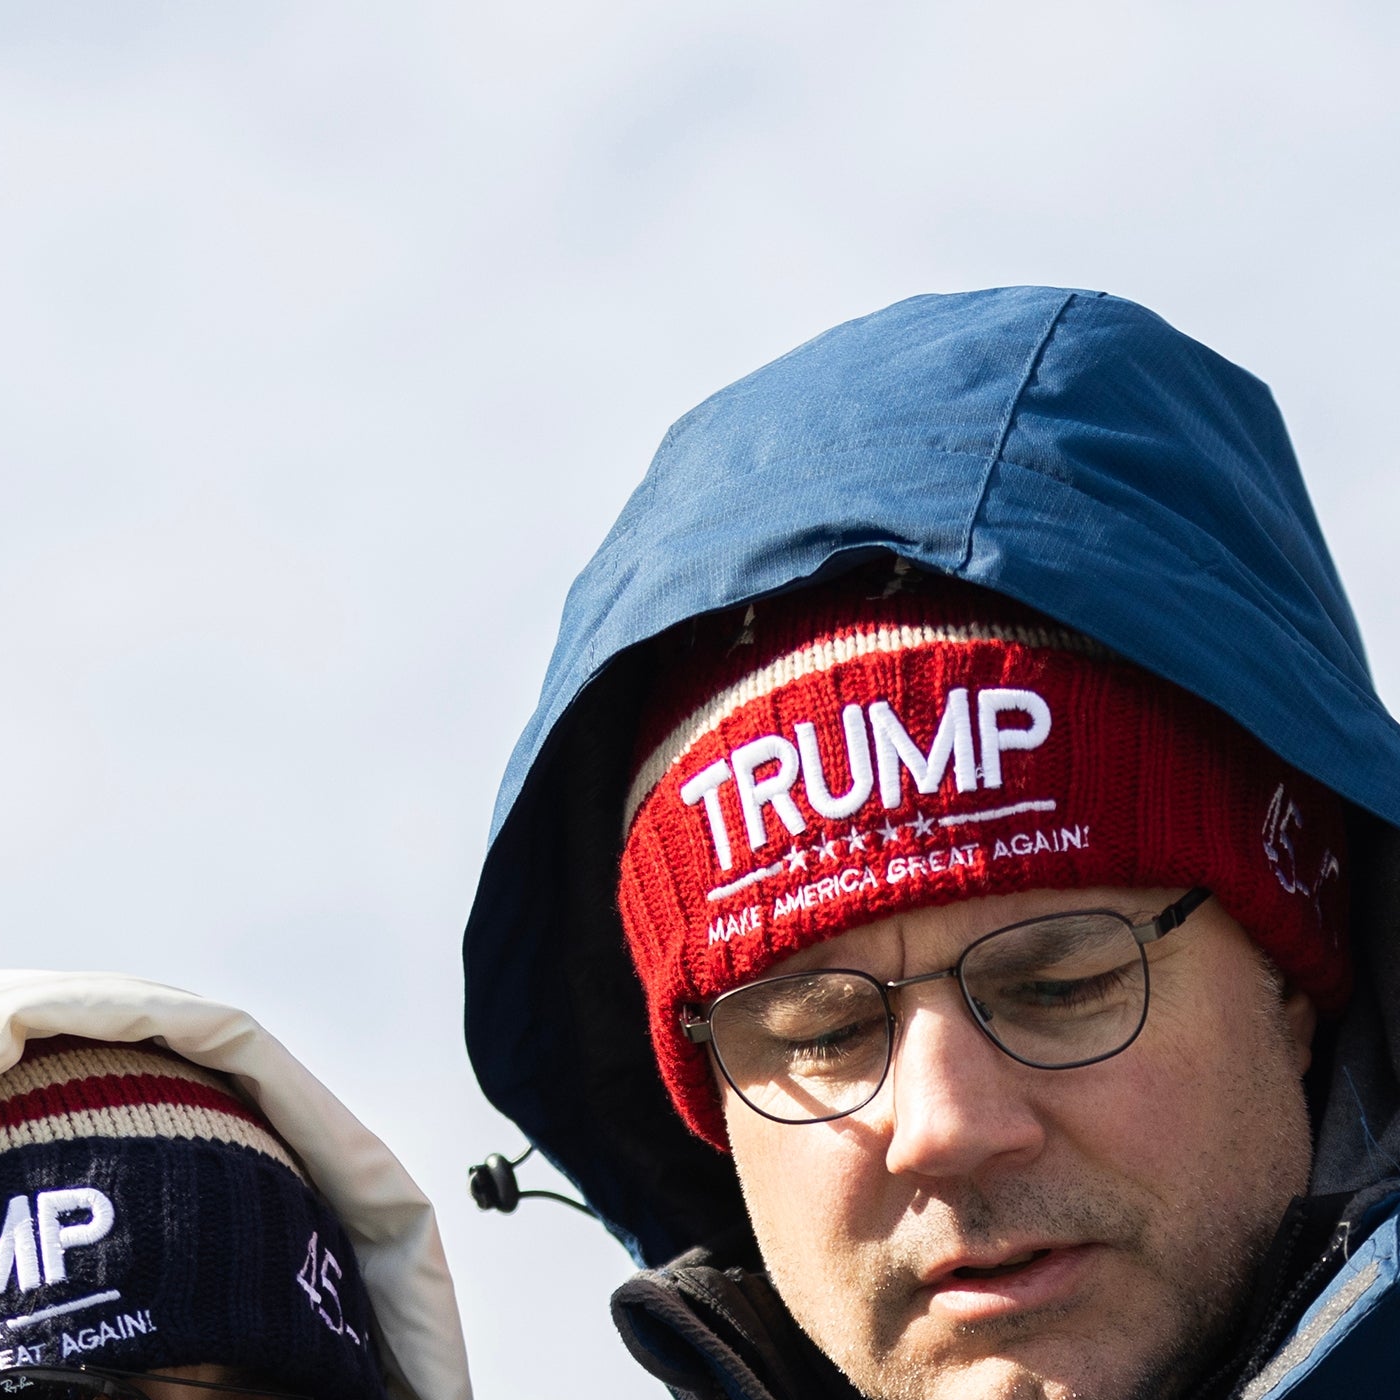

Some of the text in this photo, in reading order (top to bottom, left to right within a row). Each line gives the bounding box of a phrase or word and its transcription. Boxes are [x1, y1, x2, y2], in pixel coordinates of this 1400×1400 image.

[681, 687, 1052, 870] TRUMP
[707, 824, 1090, 946] MAKE AMERICA GREAT AGAIN!
[61, 1308, 158, 1358] AGAIN!
[0, 1375, 35, 1394] Ray-Ban
